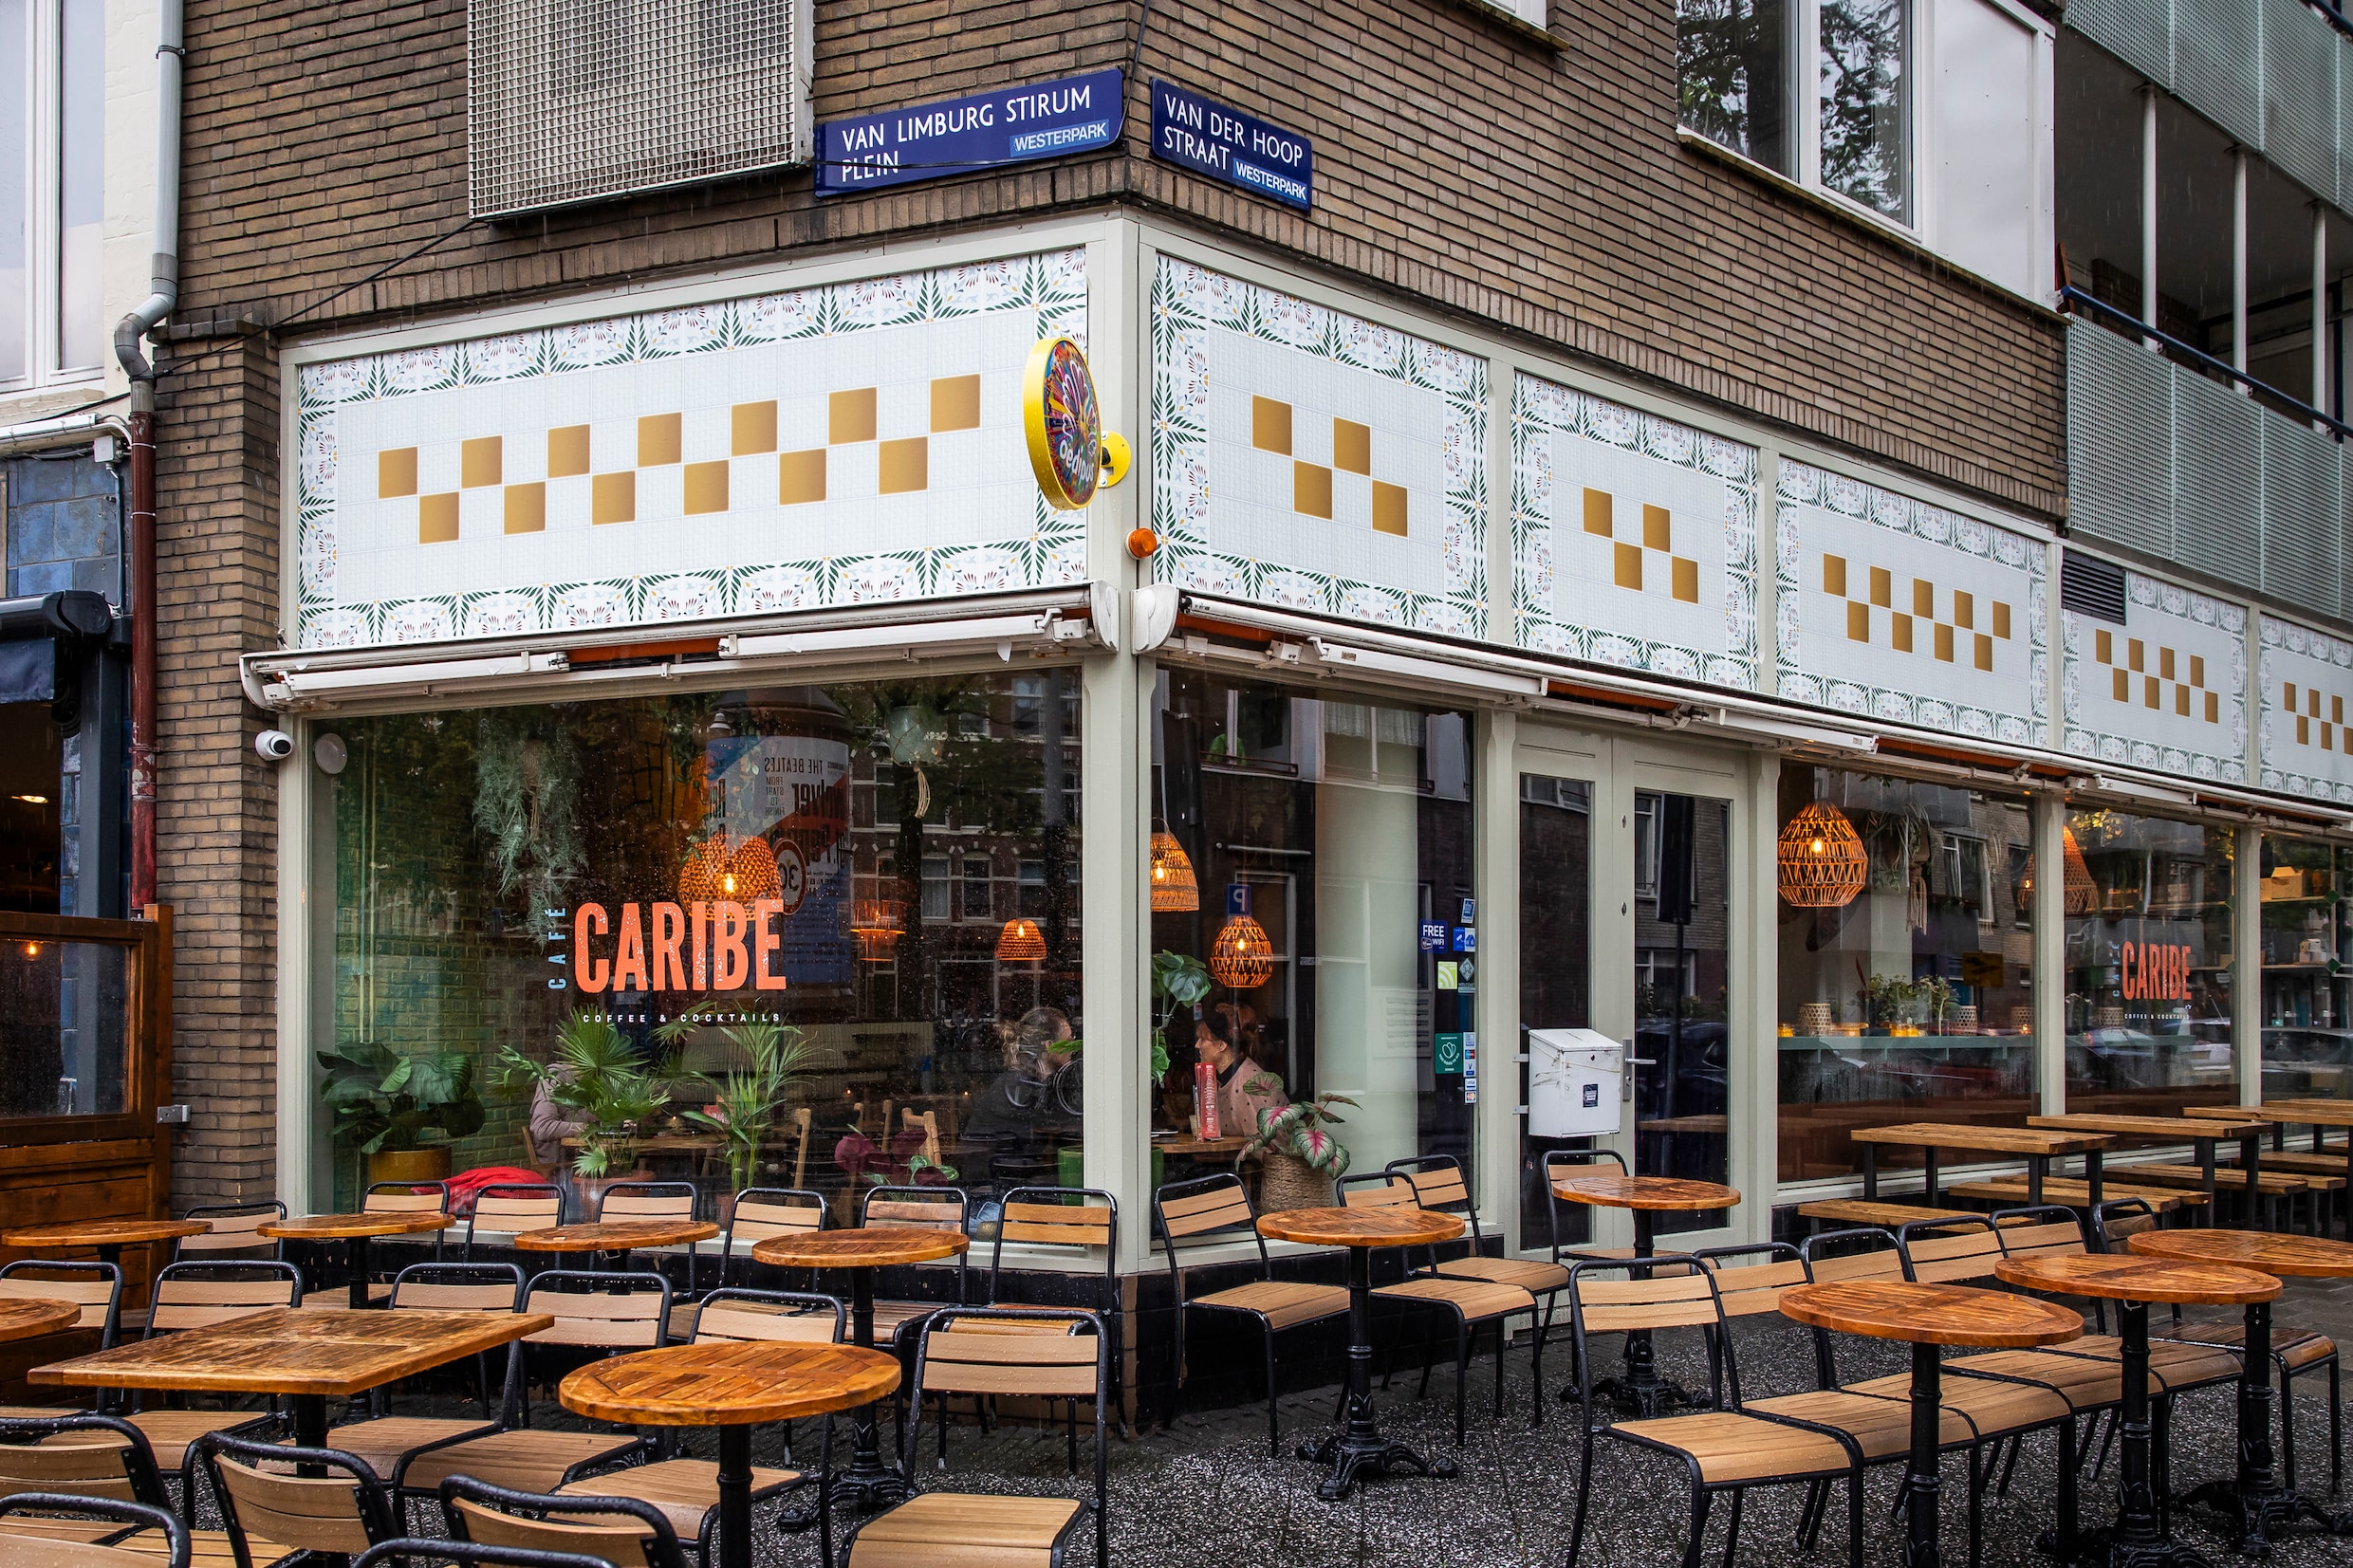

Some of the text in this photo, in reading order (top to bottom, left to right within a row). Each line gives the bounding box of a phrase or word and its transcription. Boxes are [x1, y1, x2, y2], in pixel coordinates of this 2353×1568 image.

[842, 84, 1091, 152] VAN LIMBURG STIRUM
[1014, 121, 1108, 152] WESTERPARK
[1165, 93, 1304, 168] VAN DER HOOP
[842, 151, 899, 182] PLEIN
[1163, 125, 1231, 171] STRAAT
[1235, 160, 1307, 200] WESTERPARK
[1060, 439, 1094, 485] oedipus
[545, 906, 567, 989] CAFÉ
[574, 899, 787, 993] CARIBE
[1422, 924, 1445, 938] FREE
[2121, 940, 2193, 1001] CARIBE
[583, 1013, 780, 1023] COFFEE & COCKTAILS
